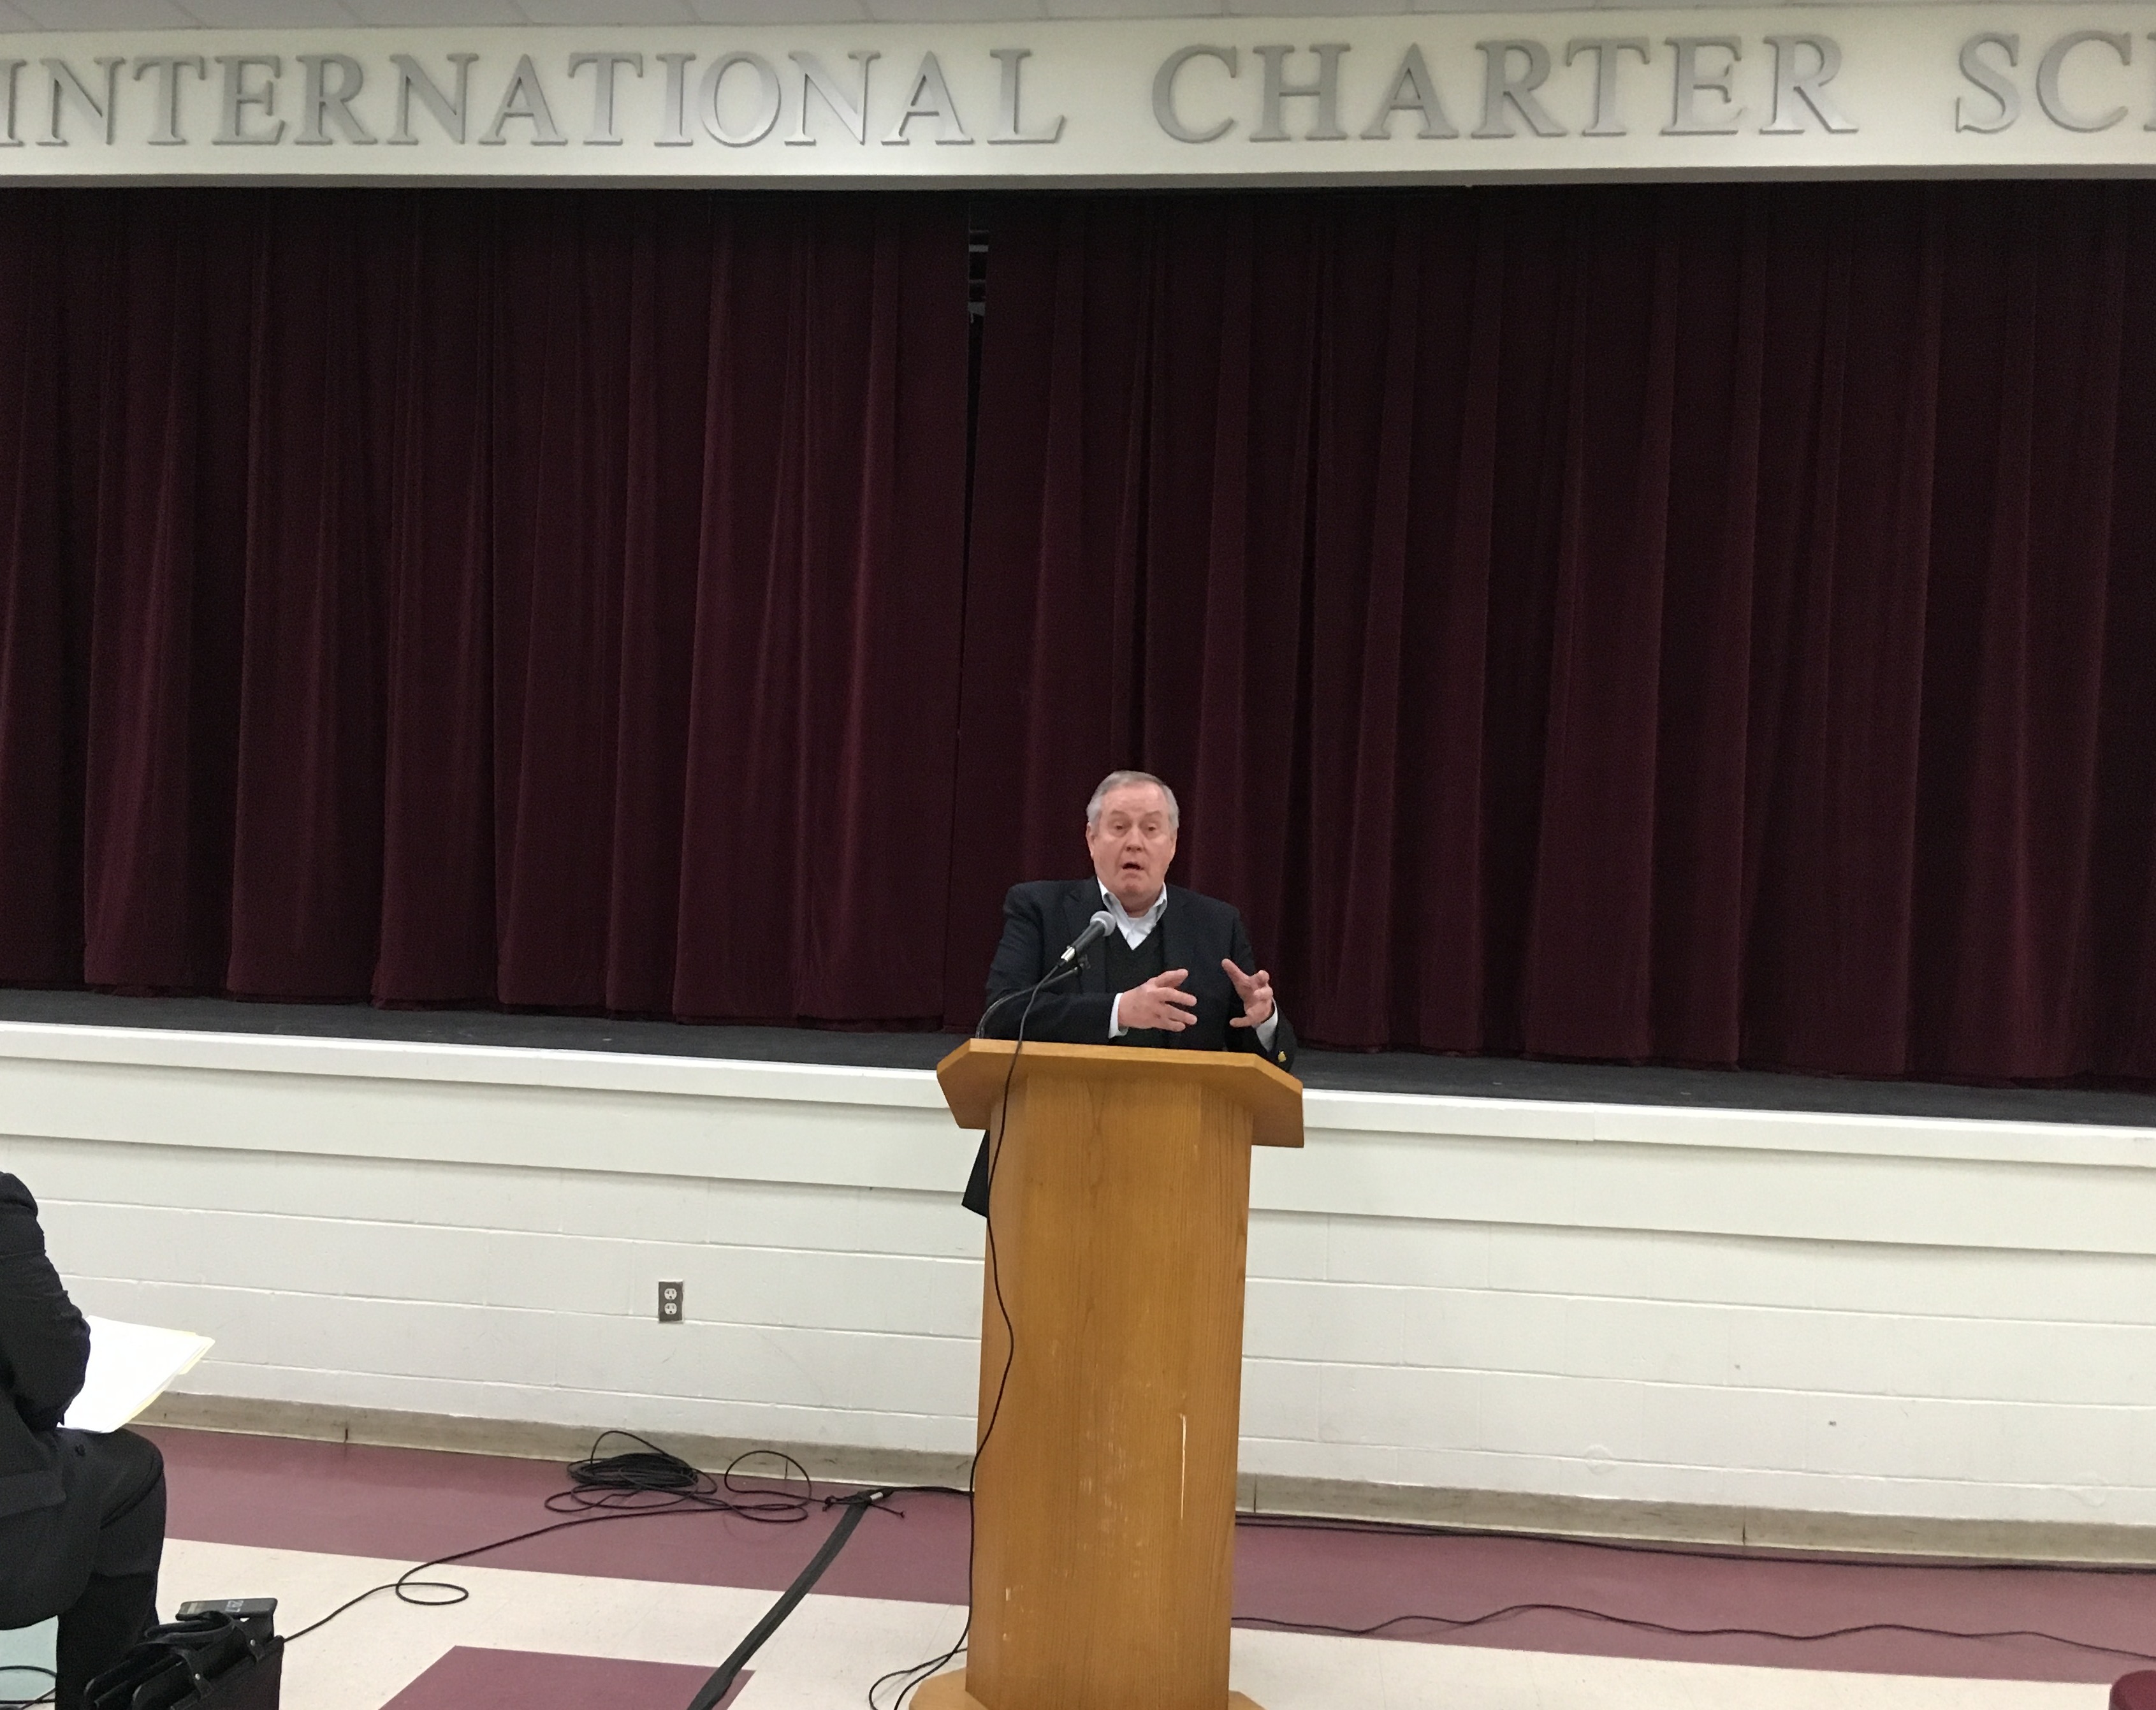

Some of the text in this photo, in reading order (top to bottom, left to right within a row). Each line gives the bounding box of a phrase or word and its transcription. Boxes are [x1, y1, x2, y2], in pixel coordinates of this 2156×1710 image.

[0, 30, 2156, 148] INTERNATIONAL CHARTER SC
